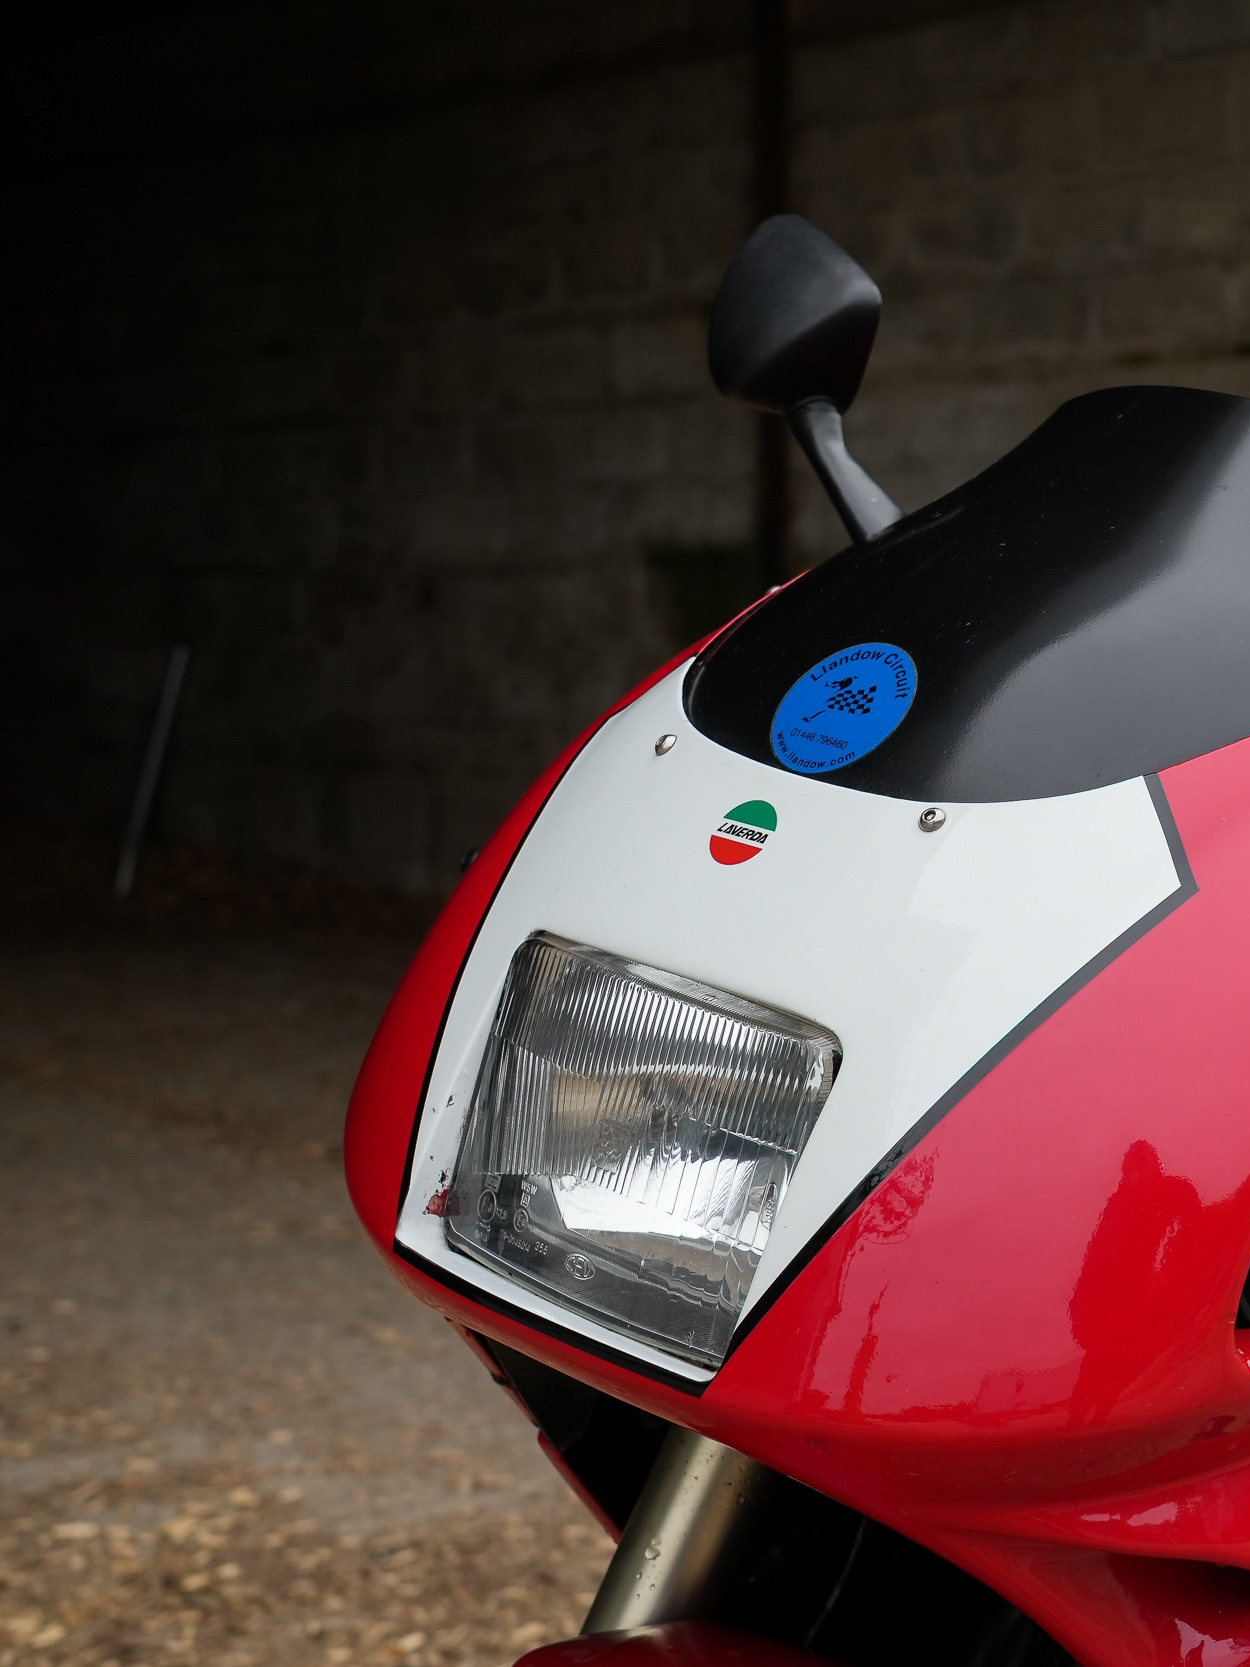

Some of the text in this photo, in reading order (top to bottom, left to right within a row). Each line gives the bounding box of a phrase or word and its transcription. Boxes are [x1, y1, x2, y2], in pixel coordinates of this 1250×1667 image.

[810, 649, 911, 700] Llandow Circuit
[777, 730, 856, 769] www.llandow.com
[790, 727, 849, 750] 01446 796460
[717, 822, 769, 844] LAVERDA
